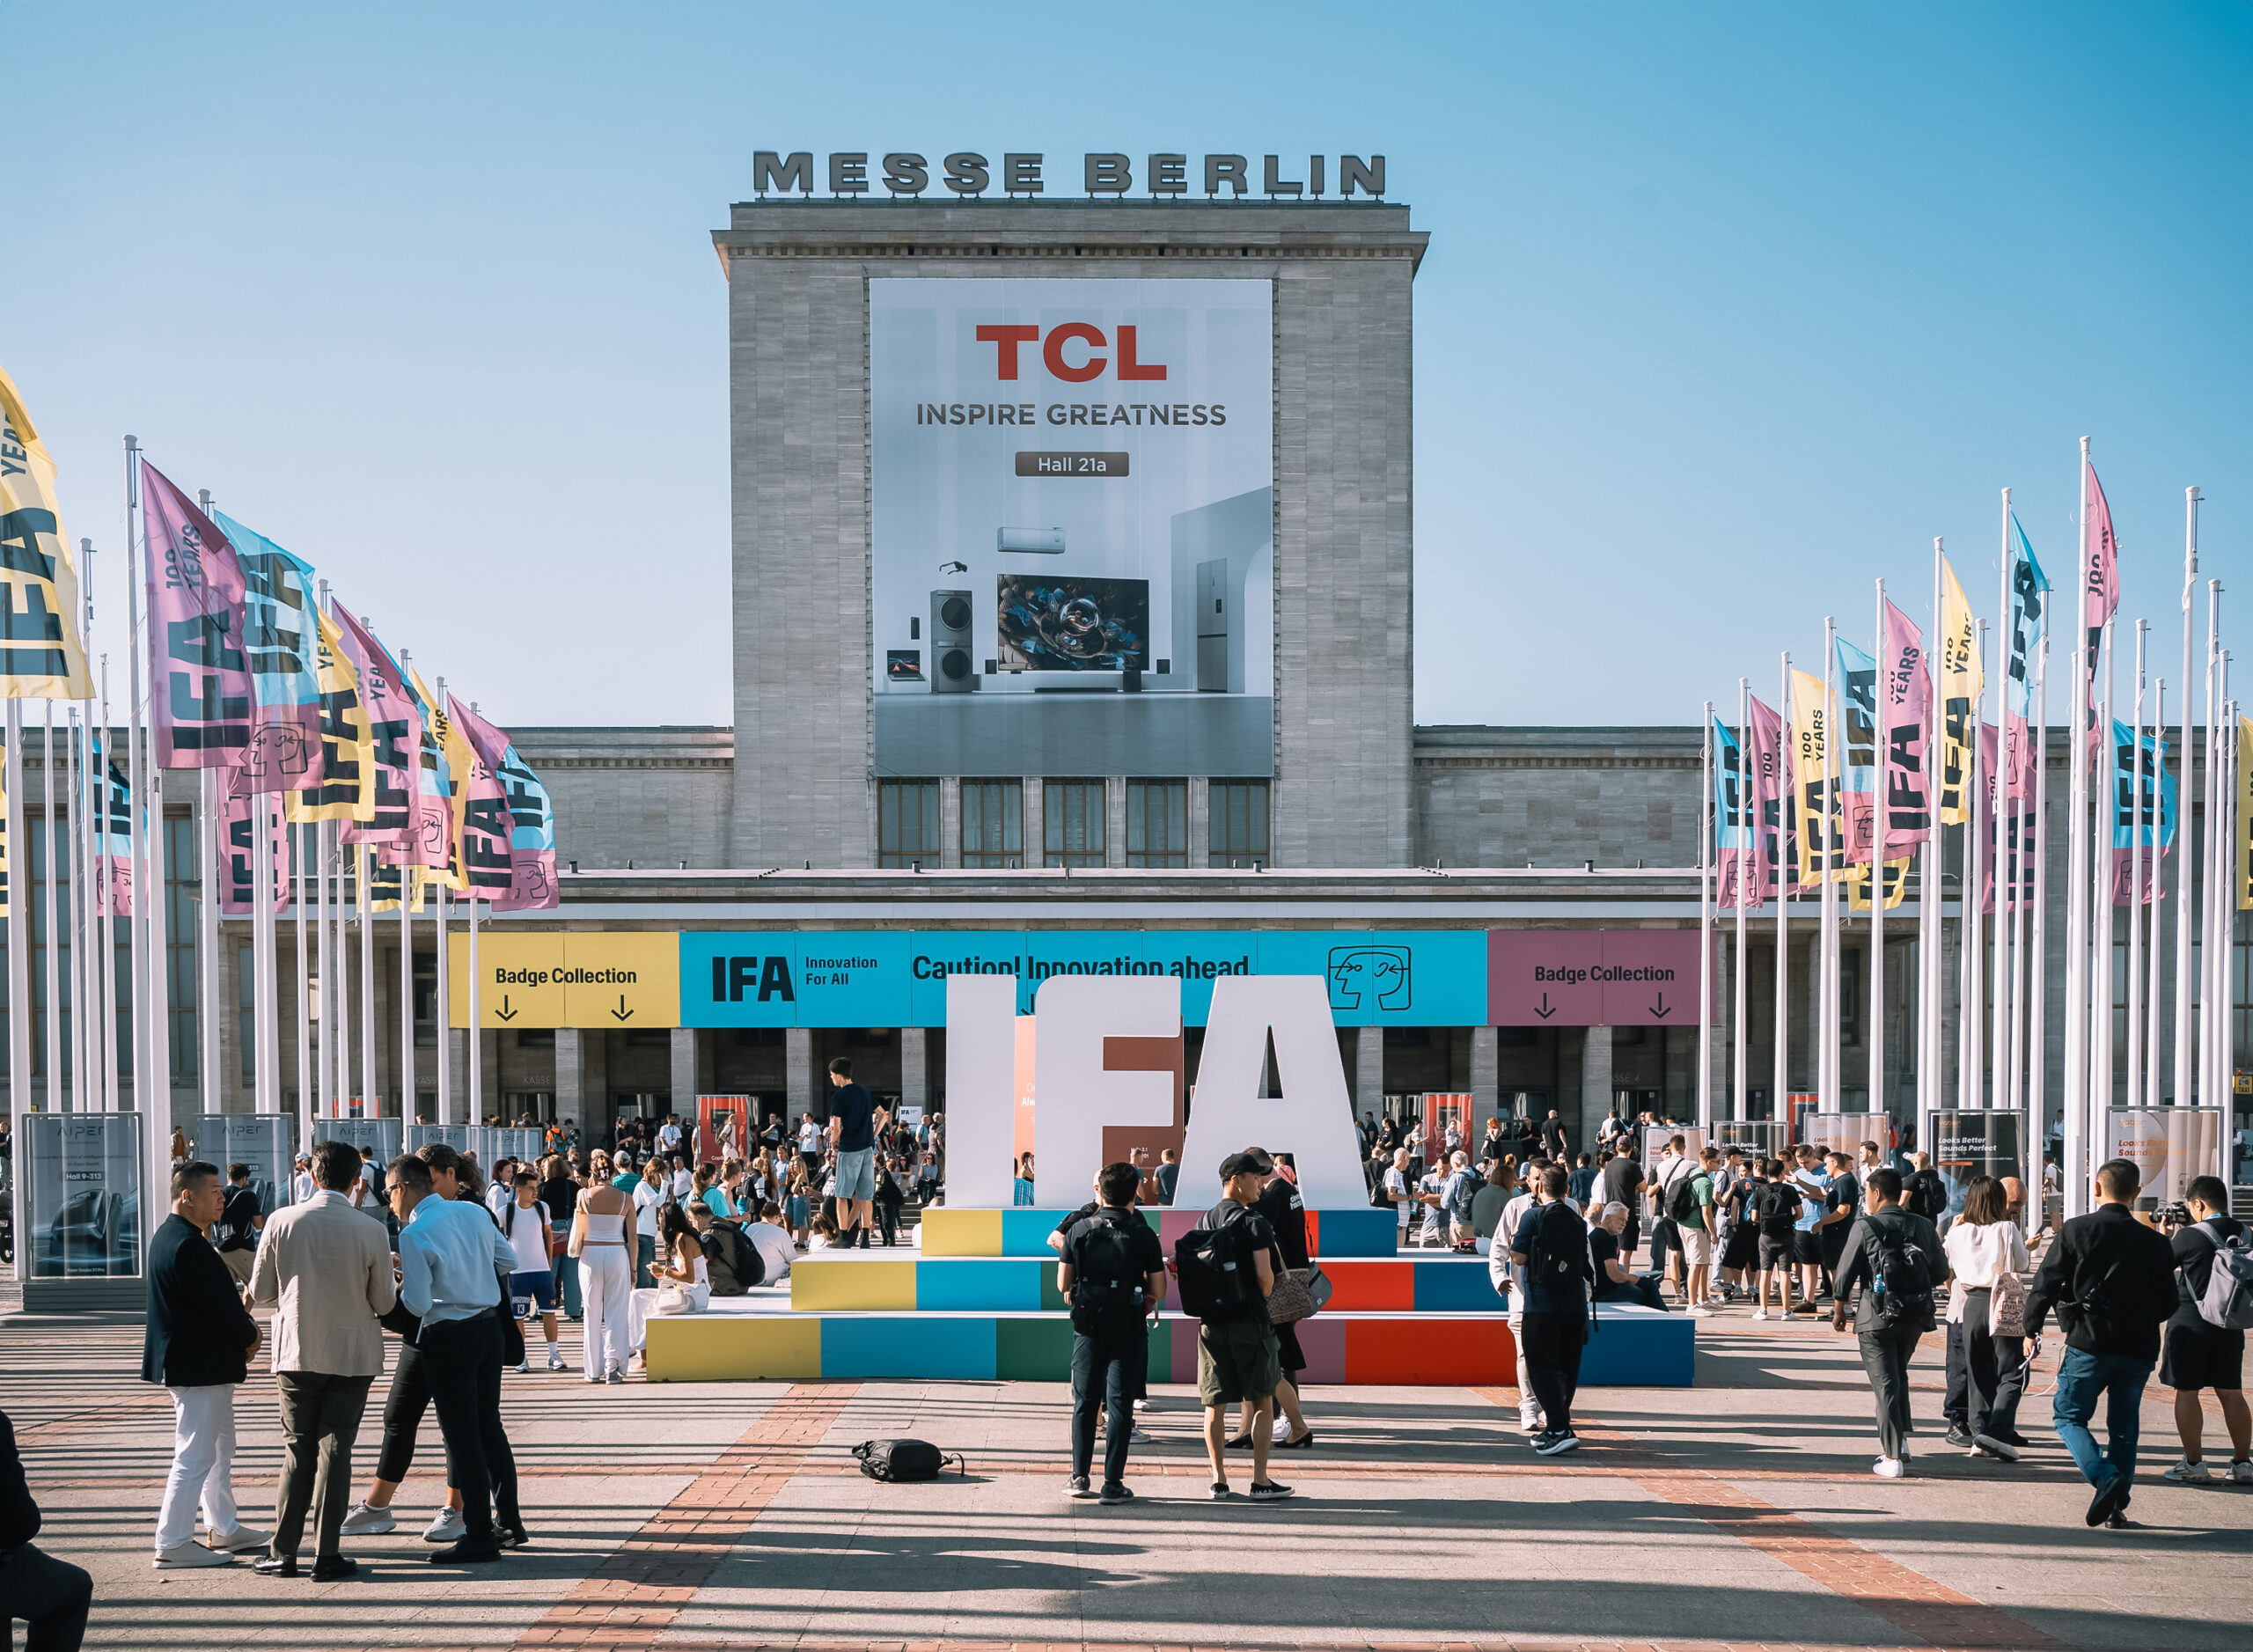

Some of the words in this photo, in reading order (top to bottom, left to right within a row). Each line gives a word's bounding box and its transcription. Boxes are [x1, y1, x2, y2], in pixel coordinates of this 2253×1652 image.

[752, 151, 1044, 194] MESSE
[1084, 153, 1386, 195] BERLIN
[976, 322, 1167, 383] TCL
[917, 403, 1036, 425] INSPIRE
[1046, 403, 1226, 426] GREATNESS
[1038, 457, 1072, 472] Hall
[1078, 457, 1106, 472] 21a
[167, 608, 252, 749] IFA
[1896, 646, 1920, 705] YEARS
[1802, 731, 1811, 760] 100
[1813, 709, 1824, 761] YEARS
[1941, 697, 1970, 809] IFA
[354, 718, 409, 830] IFA
[1763, 752, 1772, 779] 100
[1888, 723, 1932, 830] IFA
[2117, 744, 2165, 826] IFA
[464, 797, 514, 888] IFA
[495, 968, 547, 987] Badge
[551, 967, 637, 984] Collection
[712, 957, 796, 1002] IFA
[805, 957, 877, 968] Innovation
[806, 973, 826, 985] For
[831, 973, 849, 985] All
[913, 955, 1021, 980] Caution!
[1028, 955, 1163, 980] Innovation
[1170, 955, 1257, 980] ahead.
[1535, 966, 1587, 985] Badge
[1590, 966, 1675, 981] Collection
[415, 1076, 437, 1084] KASS
[524, 1076, 551, 1084] KASSE
[946, 973, 1371, 1208] IFA
[517, 1303, 525, 1315] 13
